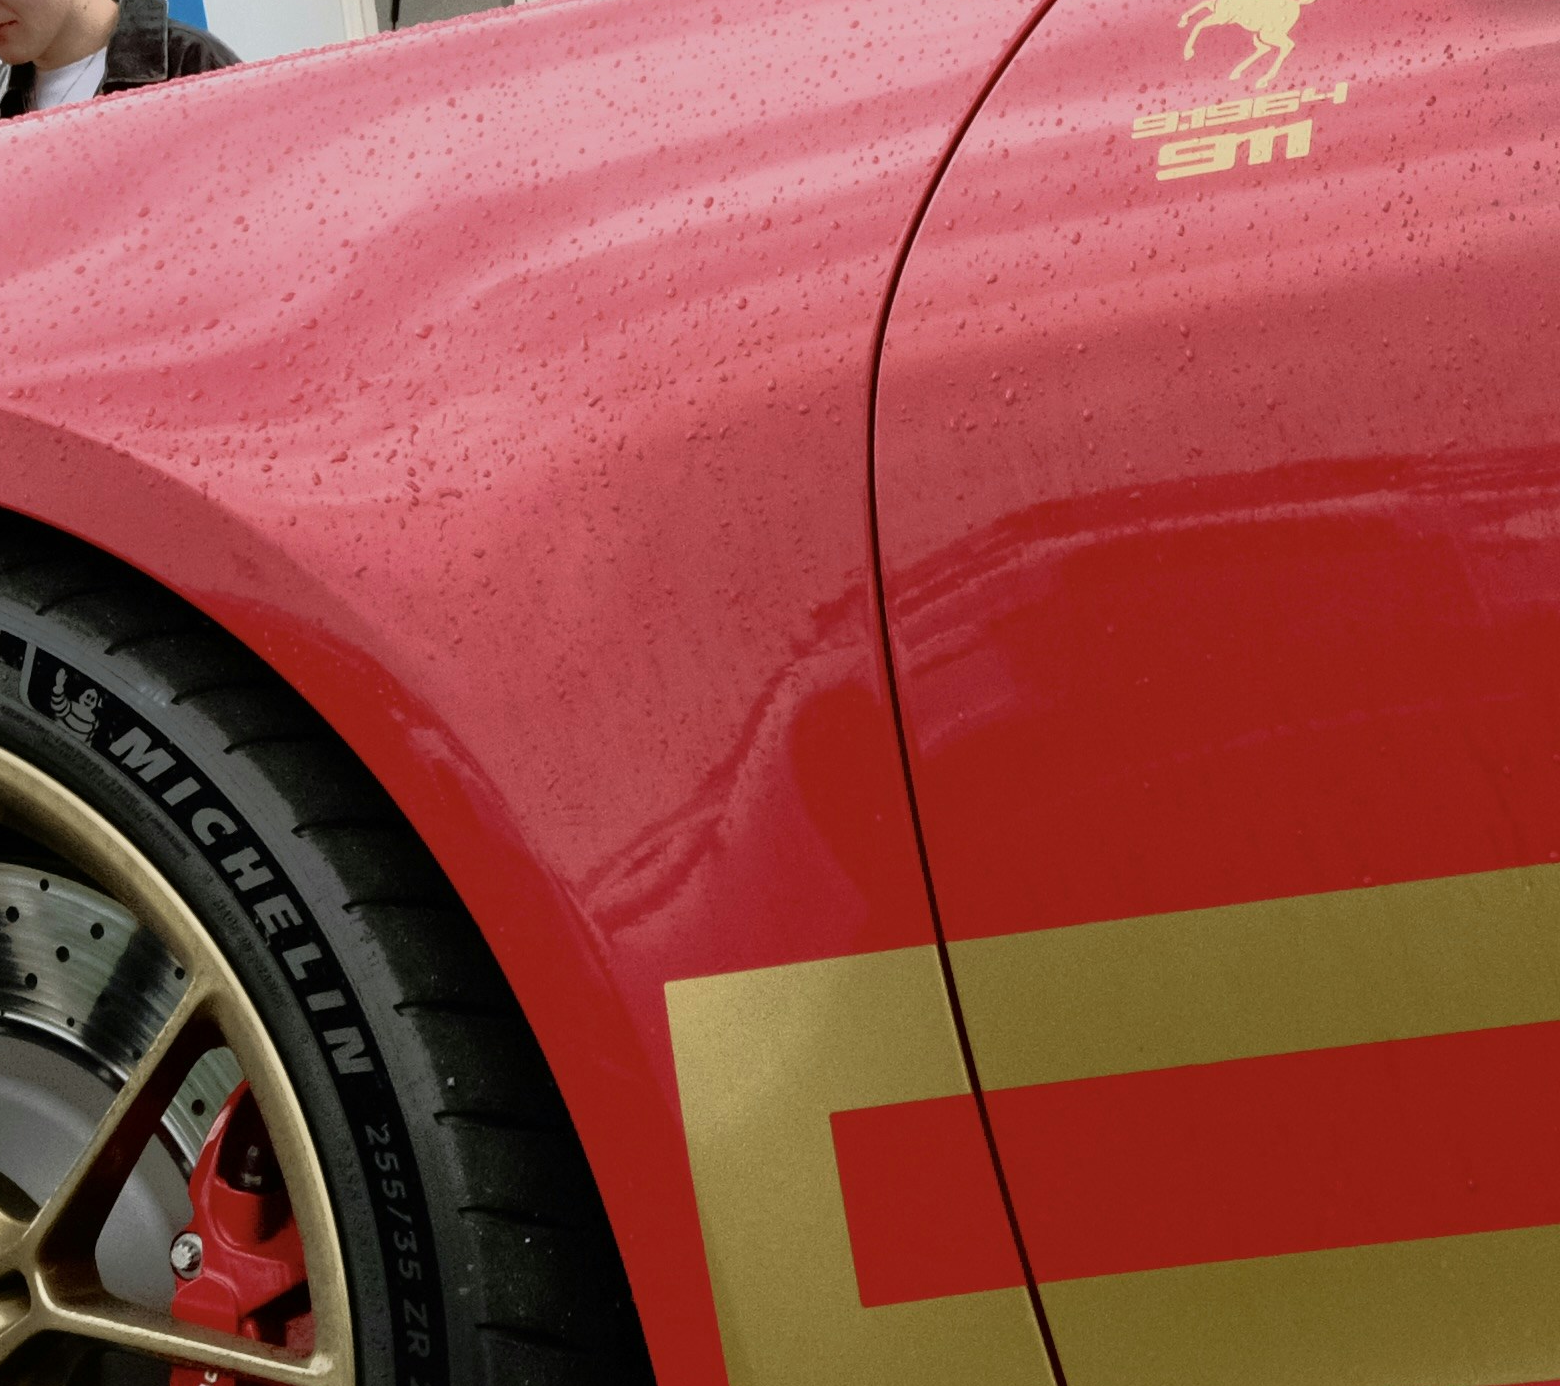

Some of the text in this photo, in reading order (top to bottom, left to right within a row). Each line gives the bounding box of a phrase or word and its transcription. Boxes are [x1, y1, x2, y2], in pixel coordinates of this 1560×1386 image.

[108, 725, 375, 1075] MICHELIN
[364, 1122, 423, 1281] 255/35
[403, 1297, 431, 1359] ZR
